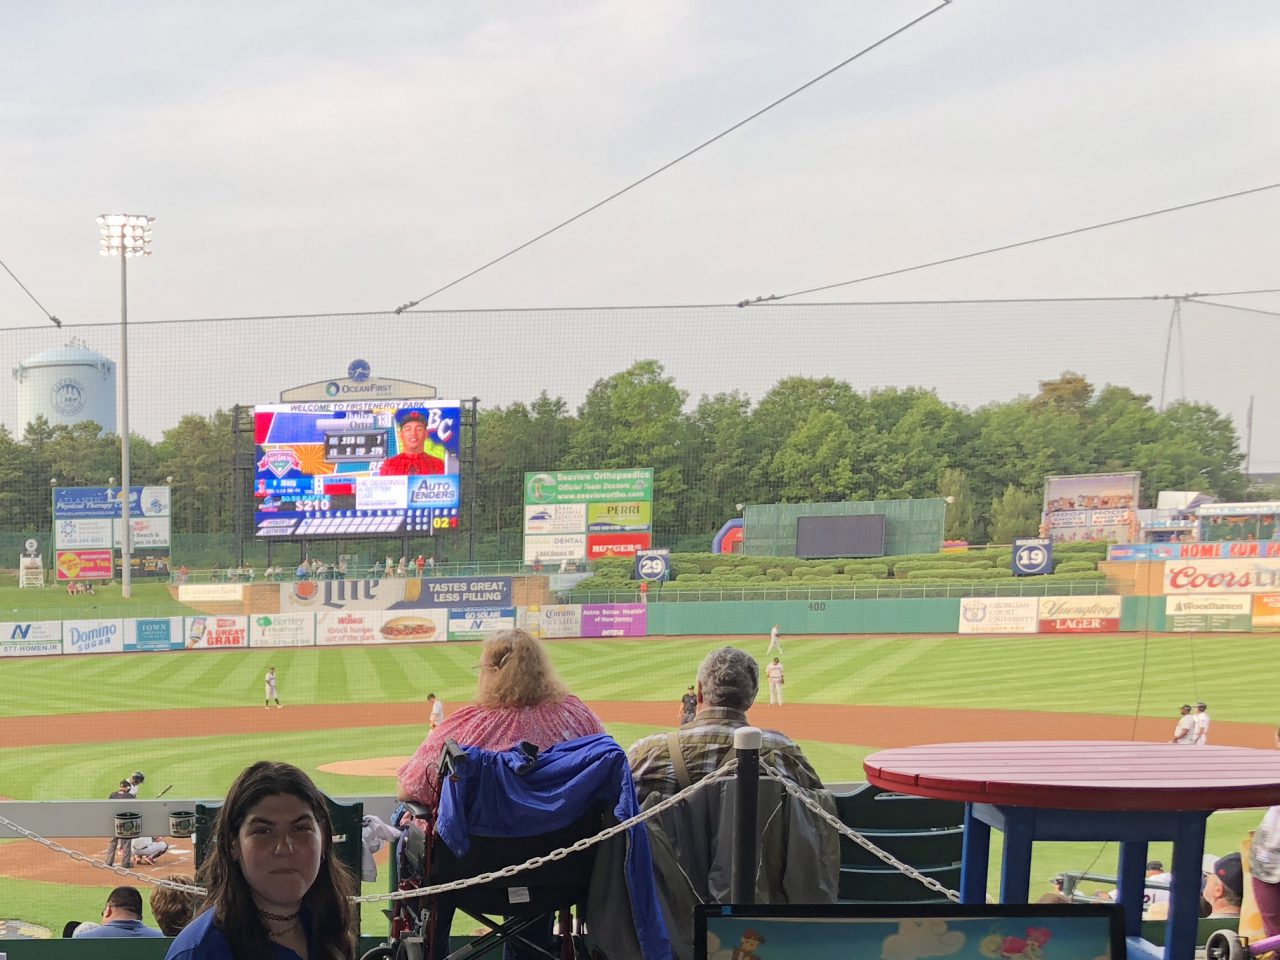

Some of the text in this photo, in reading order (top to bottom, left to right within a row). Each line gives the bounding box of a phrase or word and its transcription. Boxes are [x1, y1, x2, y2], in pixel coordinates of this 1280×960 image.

[290, 401, 425, 412] WELCOME TO FIRSTENERGY PARK
[377, 414, 390, 425] 13
[417, 480, 450, 492] AUTO
[410, 489, 455, 503] LENDERS
[56, 502, 84, 510] Physical
[295, 500, 330, 511] $210
[607, 505, 640, 515] PERRI
[1093, 509, 1127, 517] HOOP
[1019, 549, 1043, 564] 19
[1180, 544, 1221, 558] HOME
[641, 559, 662, 573] 29
[1170, 566, 1253, 589] Coors
[428, 581, 507, 593] TASTES GREAT,
[433, 591, 502, 602] LESS FILLING
[808, 602, 826, 612] 400
[1042, 599, 1117, 618] Yuengling
[1183, 602, 1244, 610] Woodhaven
[337, 613, 363, 625] Wawa
[464, 611, 476, 619] GO
[545, 608, 576, 619] Corona
[988, 615, 1036, 623] UNIVERSITY
[142, 623, 167, 631] TOWN
[1054, 618, 1102, 630] LAGER
[70, 623, 117, 646] Domino
[214, 629, 246, 637] GREAT
[347, 627, 374, 635] hunger
[78, 637, 111, 652] SUGAR
[206, 634, 246, 646] GRAB!
